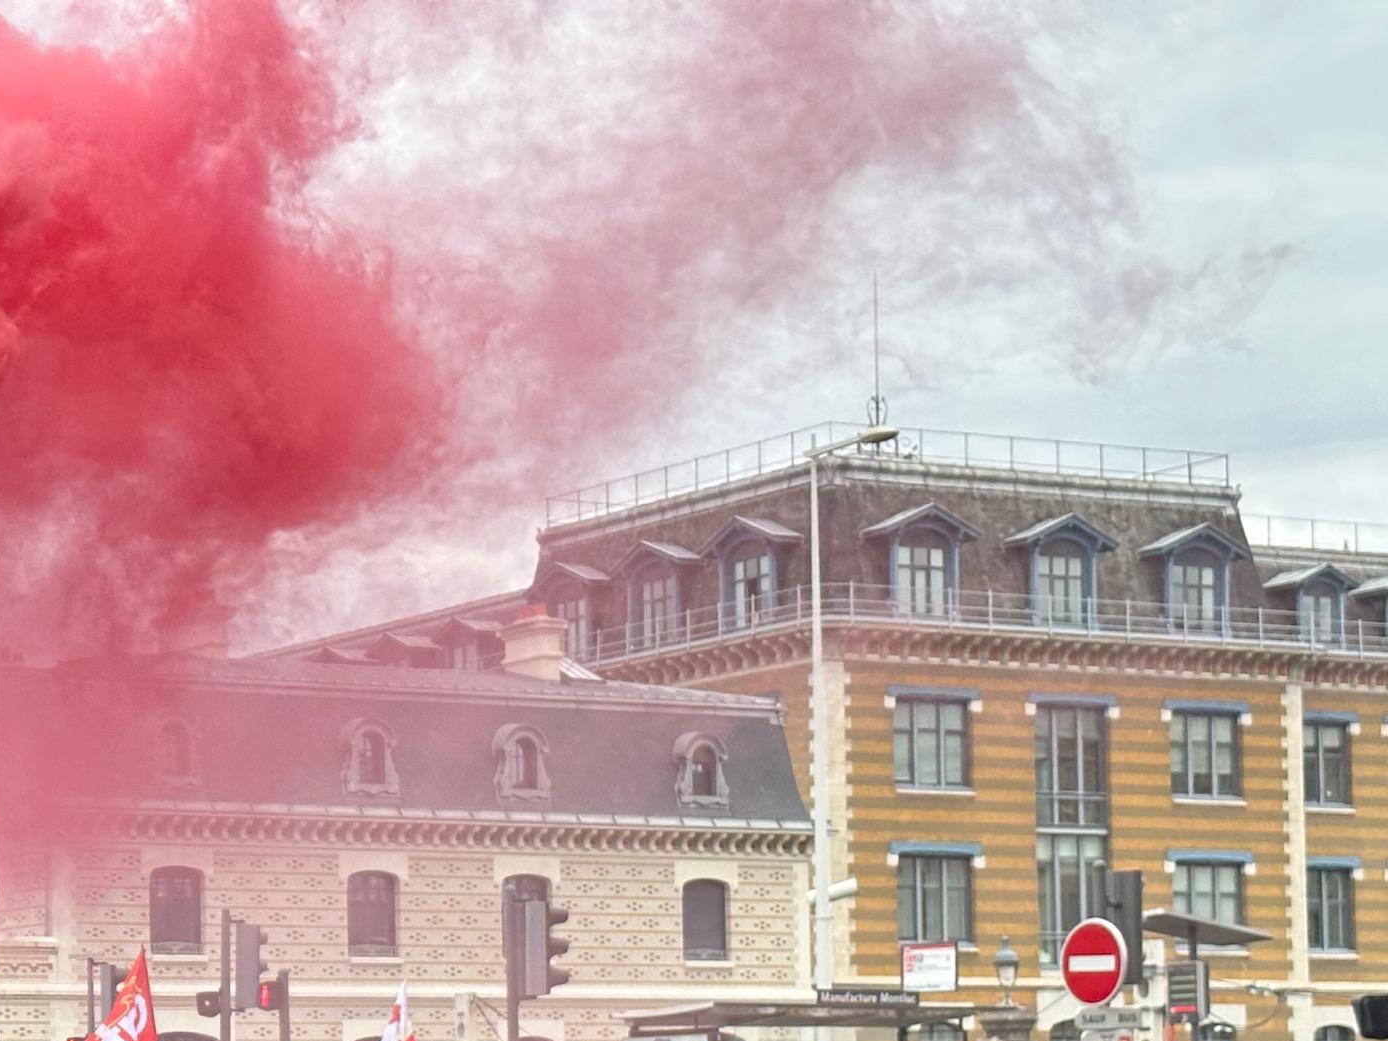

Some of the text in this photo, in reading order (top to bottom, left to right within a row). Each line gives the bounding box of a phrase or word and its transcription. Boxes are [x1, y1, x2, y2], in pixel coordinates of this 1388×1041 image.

[820, 991, 877, 1003] Manufacture
[1081, 1012, 1137, 1024] SAUF BUS
